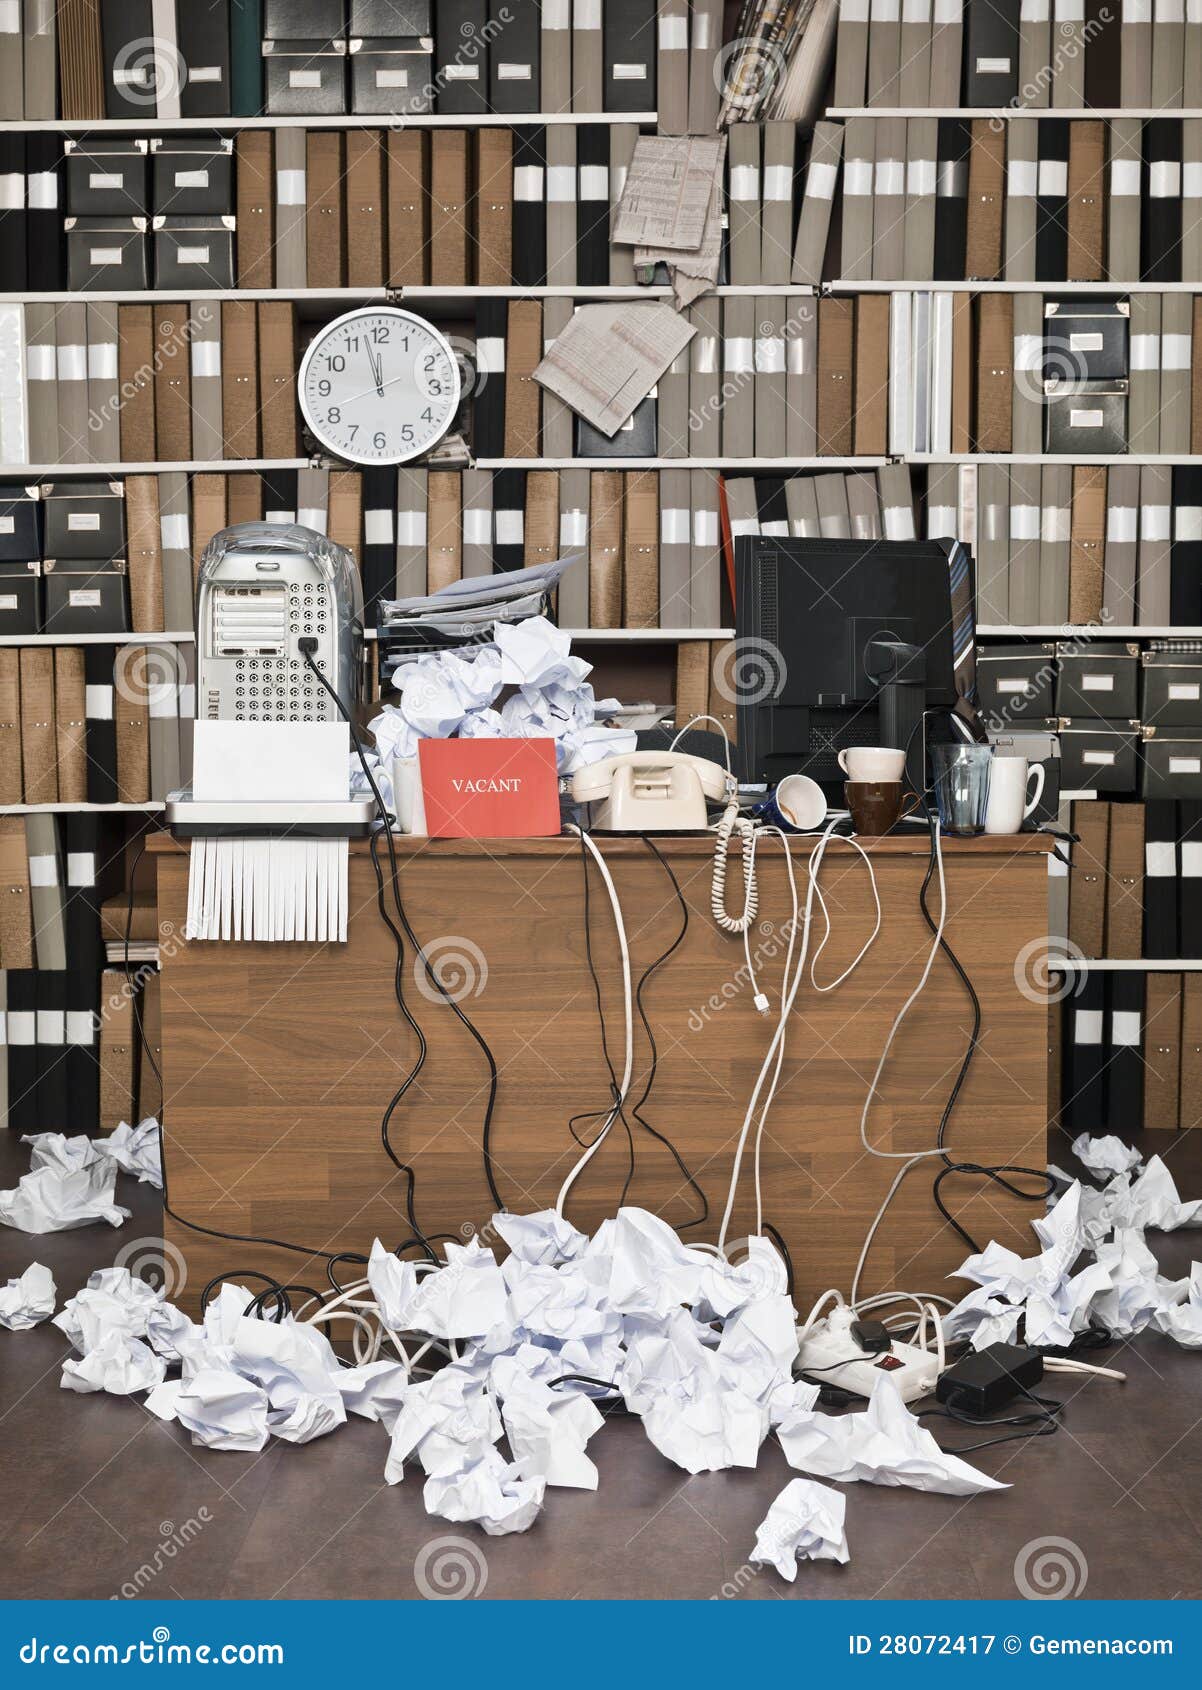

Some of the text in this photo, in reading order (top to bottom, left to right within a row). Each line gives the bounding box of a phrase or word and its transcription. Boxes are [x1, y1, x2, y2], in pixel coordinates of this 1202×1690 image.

[344, 336, 359, 352] 11
[371, 327, 390, 344] 12
[401, 336, 408, 352] 1
[325, 355, 345, 372] 10
[424, 355, 435, 371] 2
[318, 379, 331, 397] 9
[428, 379, 442, 396] 3
[327, 407, 341, 424] 8
[420, 407, 434, 423] 4
[348, 425, 359, 441] 7
[373, 432, 386, 449] 6
[401, 424, 414, 441] 5
[452, 779, 521, 793] VACANT
